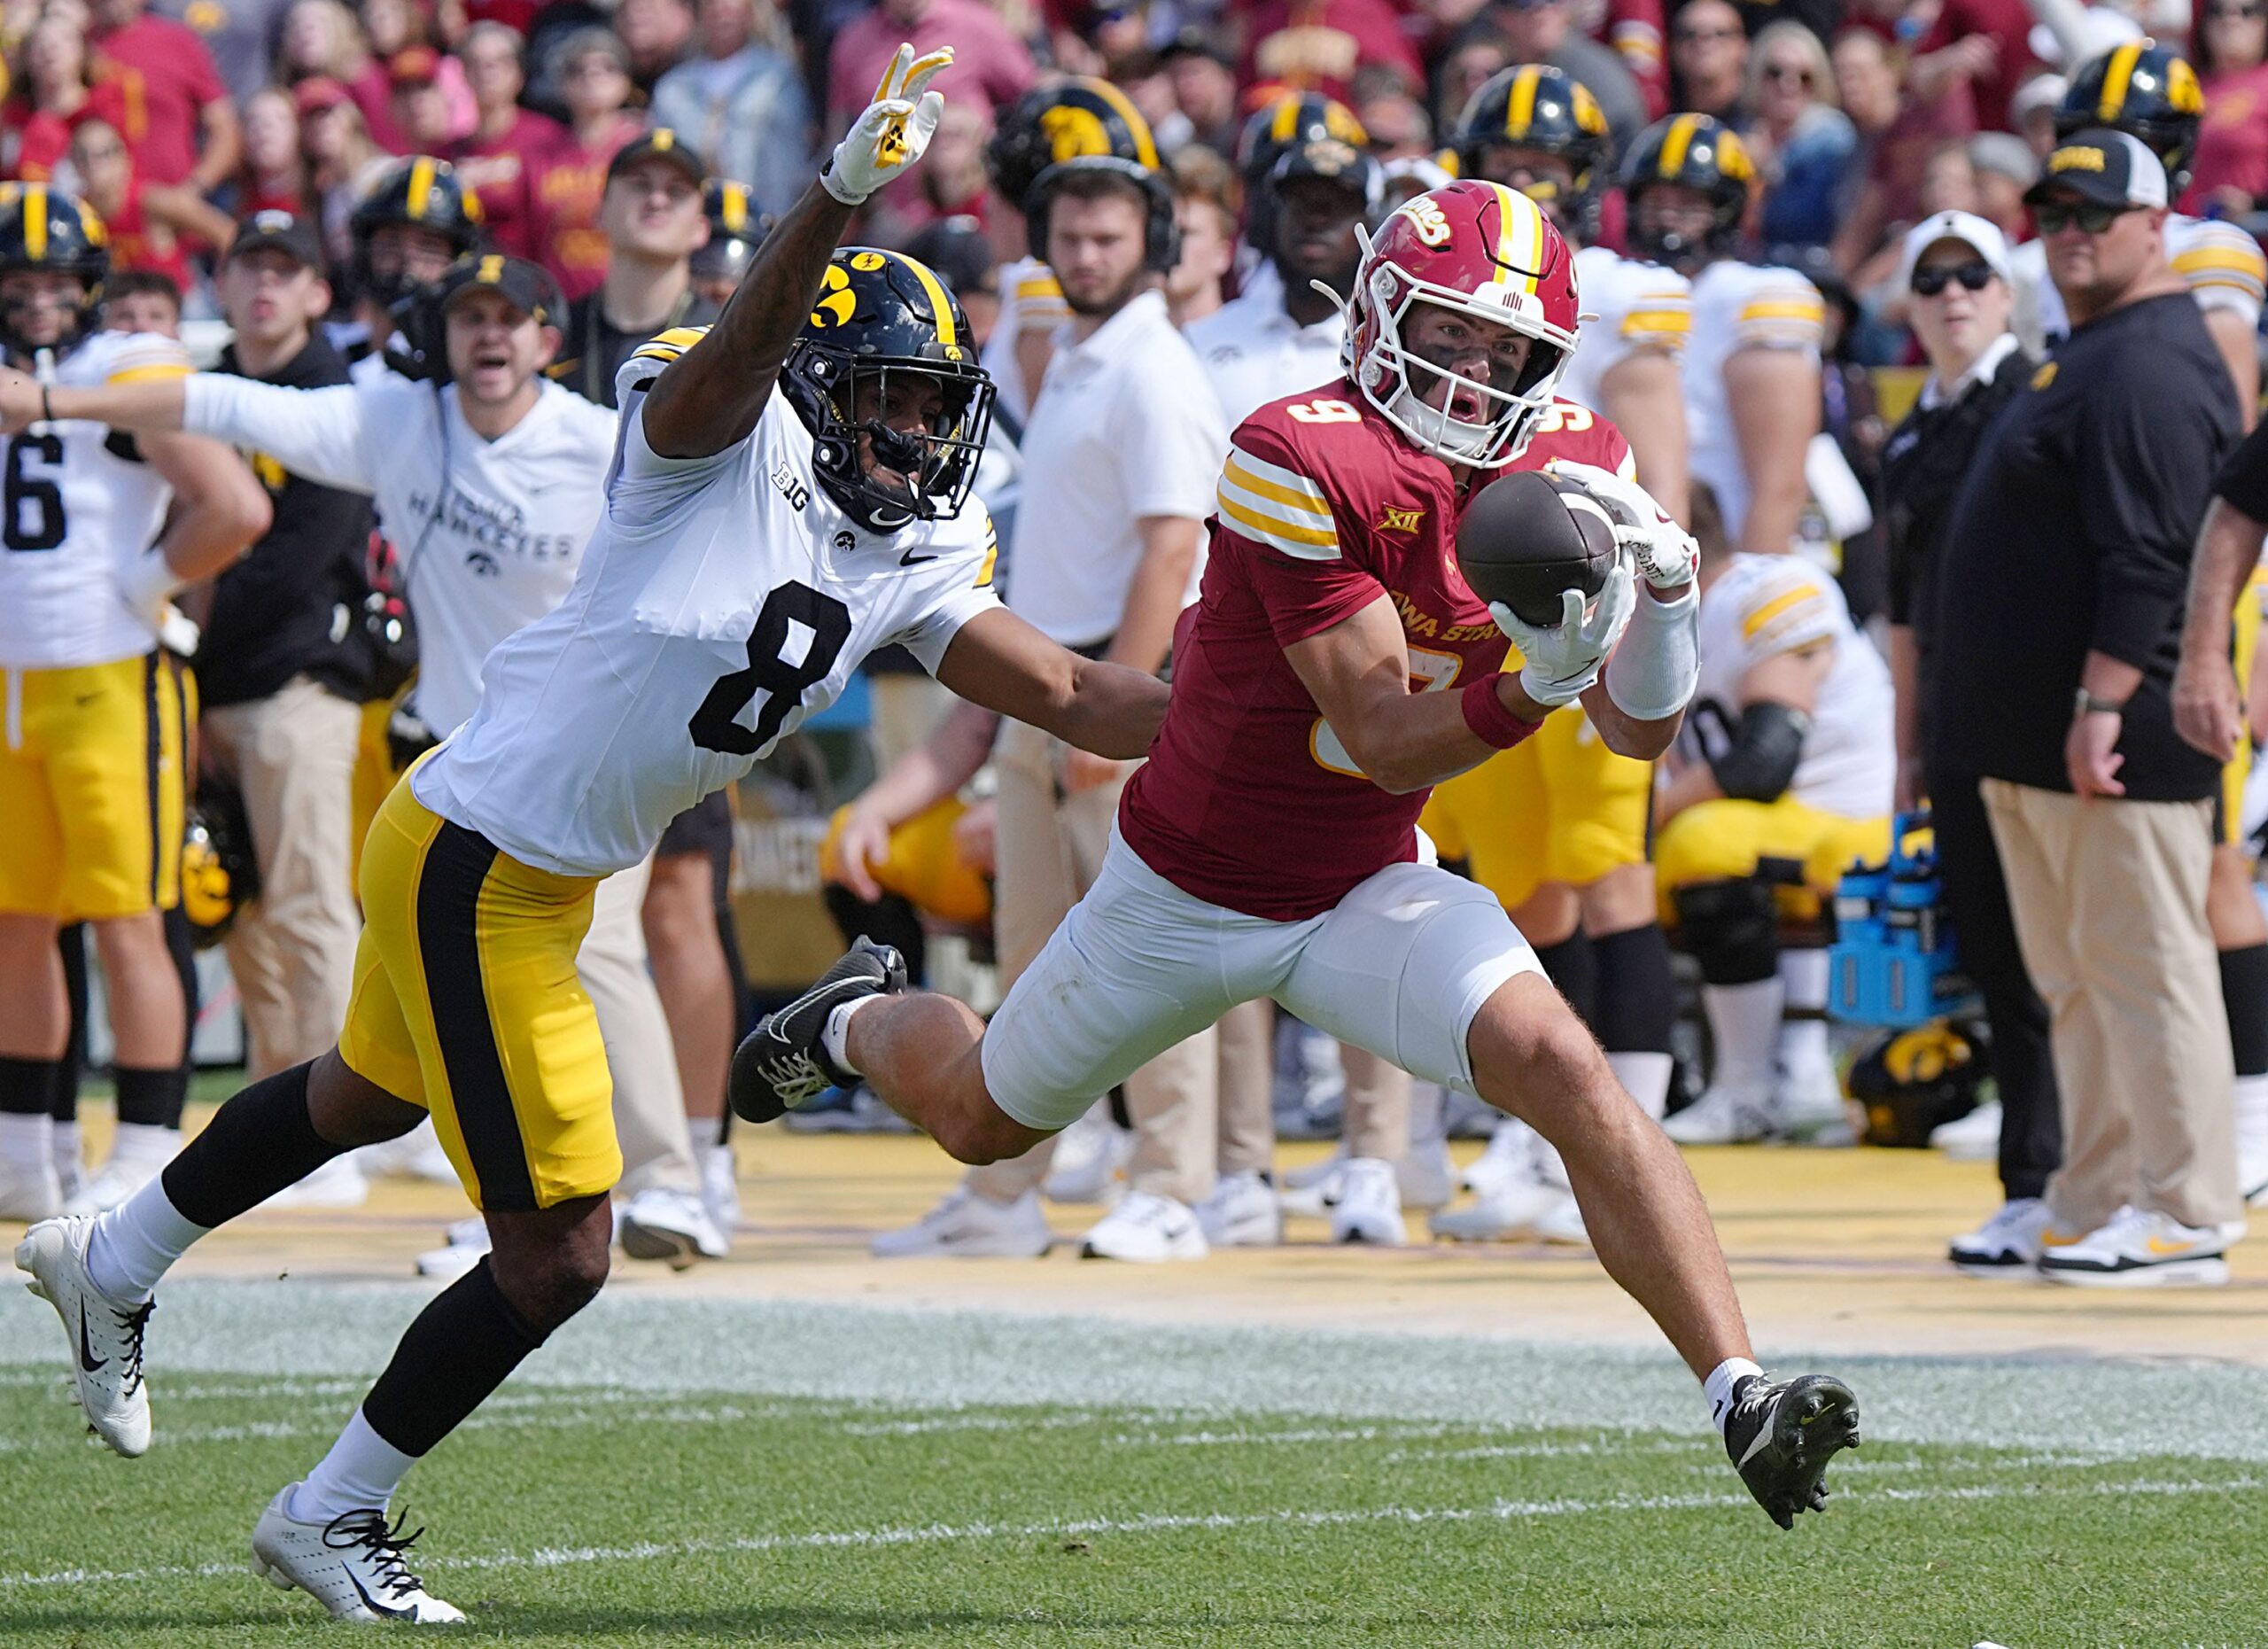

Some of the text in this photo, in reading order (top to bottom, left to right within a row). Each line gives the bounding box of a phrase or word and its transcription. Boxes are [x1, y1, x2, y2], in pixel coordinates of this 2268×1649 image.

[1285, 399, 1363, 424] 9
[3, 432, 67, 551] 6
[1377, 507, 1426, 534] XII
[1440, 623, 1500, 642] STA
[687, 579, 852, 757] 8
